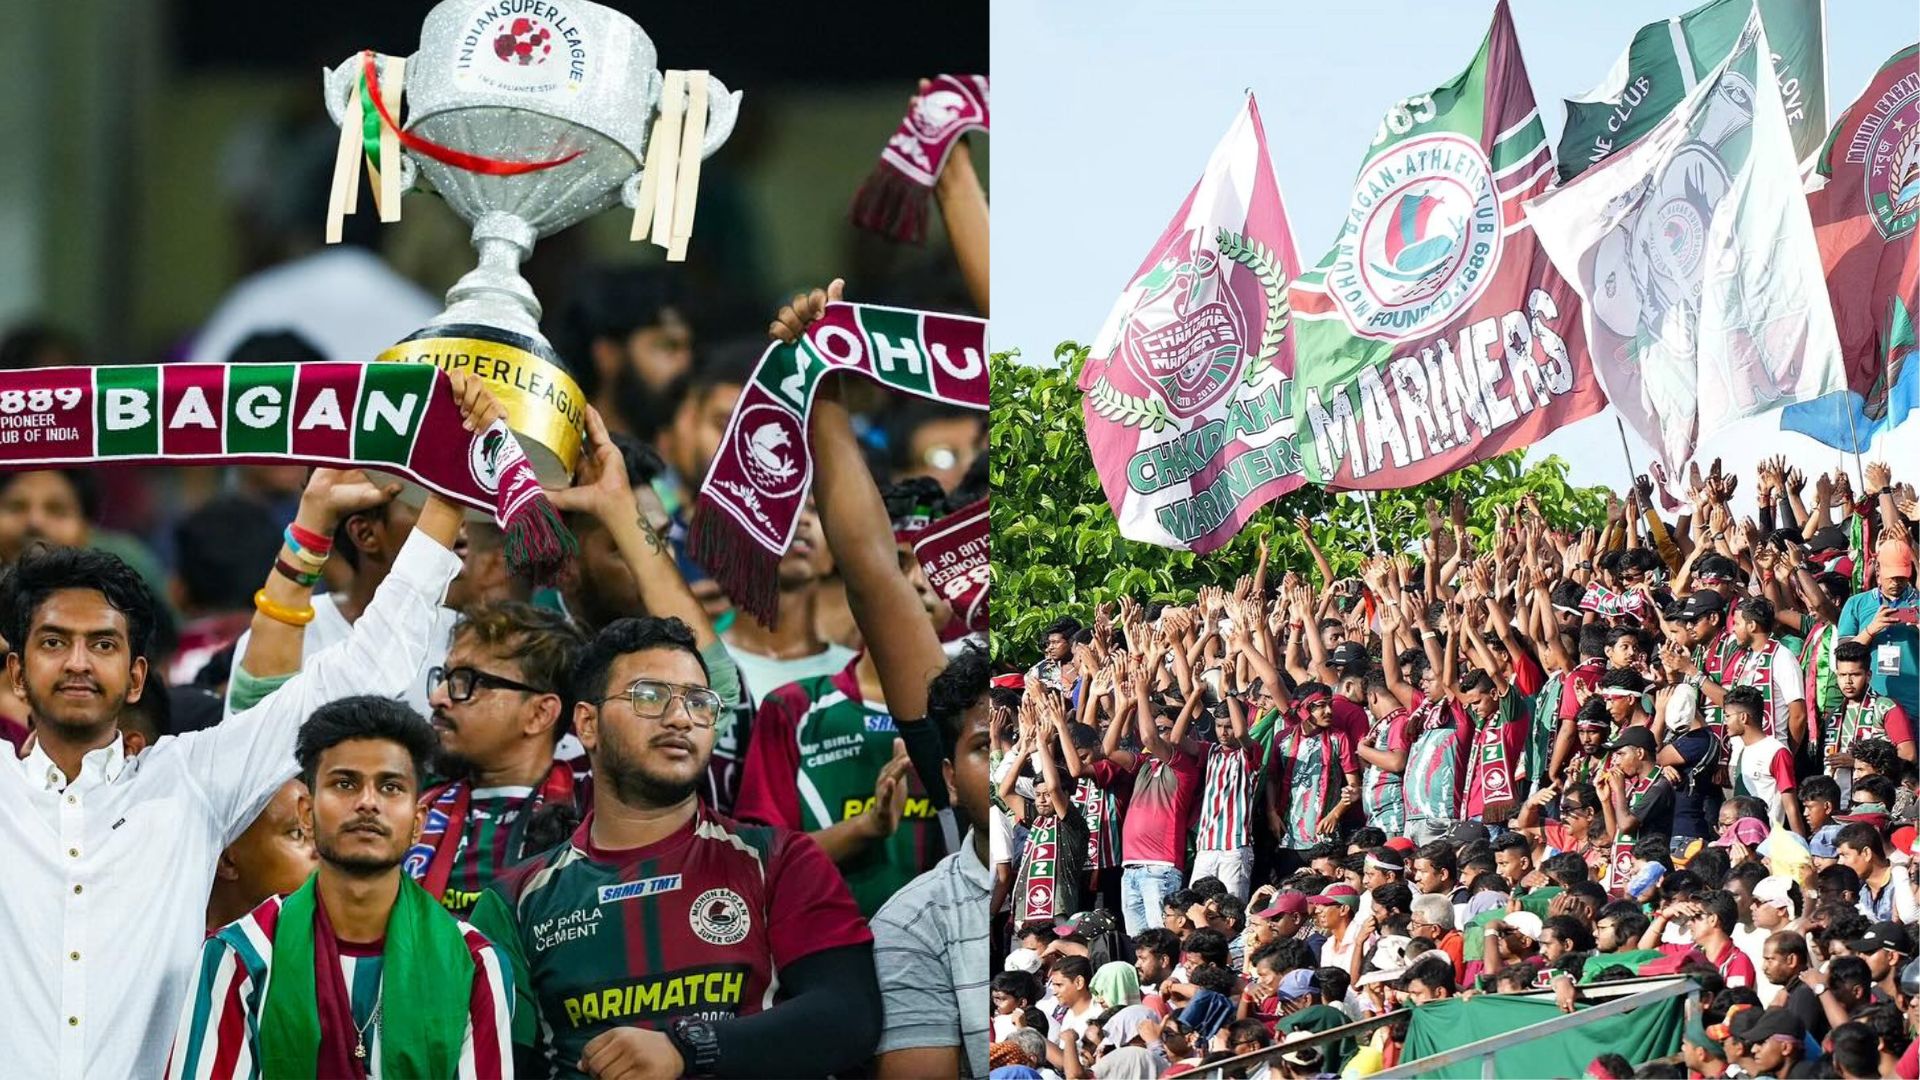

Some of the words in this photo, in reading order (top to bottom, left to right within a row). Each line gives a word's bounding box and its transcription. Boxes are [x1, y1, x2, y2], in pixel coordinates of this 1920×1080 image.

[457, 6, 499, 68] INDIAN
[499, 0, 559, 22] SUPER
[554, 16, 586, 83] LEAGUE
[1608, 76, 1650, 132] CLUB
[1776, 65, 1804, 126] LOVE
[1845, 113, 1882, 163] MOHUN
[1874, 72, 1920, 115] BAGAN
[1345, 168, 1400, 235] BAGAN
[1336, 244, 1371, 318] MOHUN
[1370, 291, 1450, 328] FOUNDED
[514, 366, 583, 431] LEAGUE
[1196, 381, 1217, 400] 2015
[1306, 288, 1574, 481] MARINERS
[0, 413, 57, 429] PIONEER
[105, 384, 418, 438] BAGAN
[24, 428, 42, 442] OF
[45, 427, 80, 441] INDIA
[930, 552, 987, 587] PIONEER
[938, 550, 957, 567] OF
[807, 745, 863, 768] CEMENT
[823, 733, 865, 750] BIRLA
[602, 881, 645, 901] SRMB
[649, 876, 681, 891] TMT
[691, 890, 717, 917] MOHUN
[720, 890, 748, 916] BAGAN
[535, 921, 600, 952] CEMENT
[698, 928, 722, 944] SUPER
[725, 928, 747, 943] GIANT
[564, 971, 745, 1029] PARIMATCH
